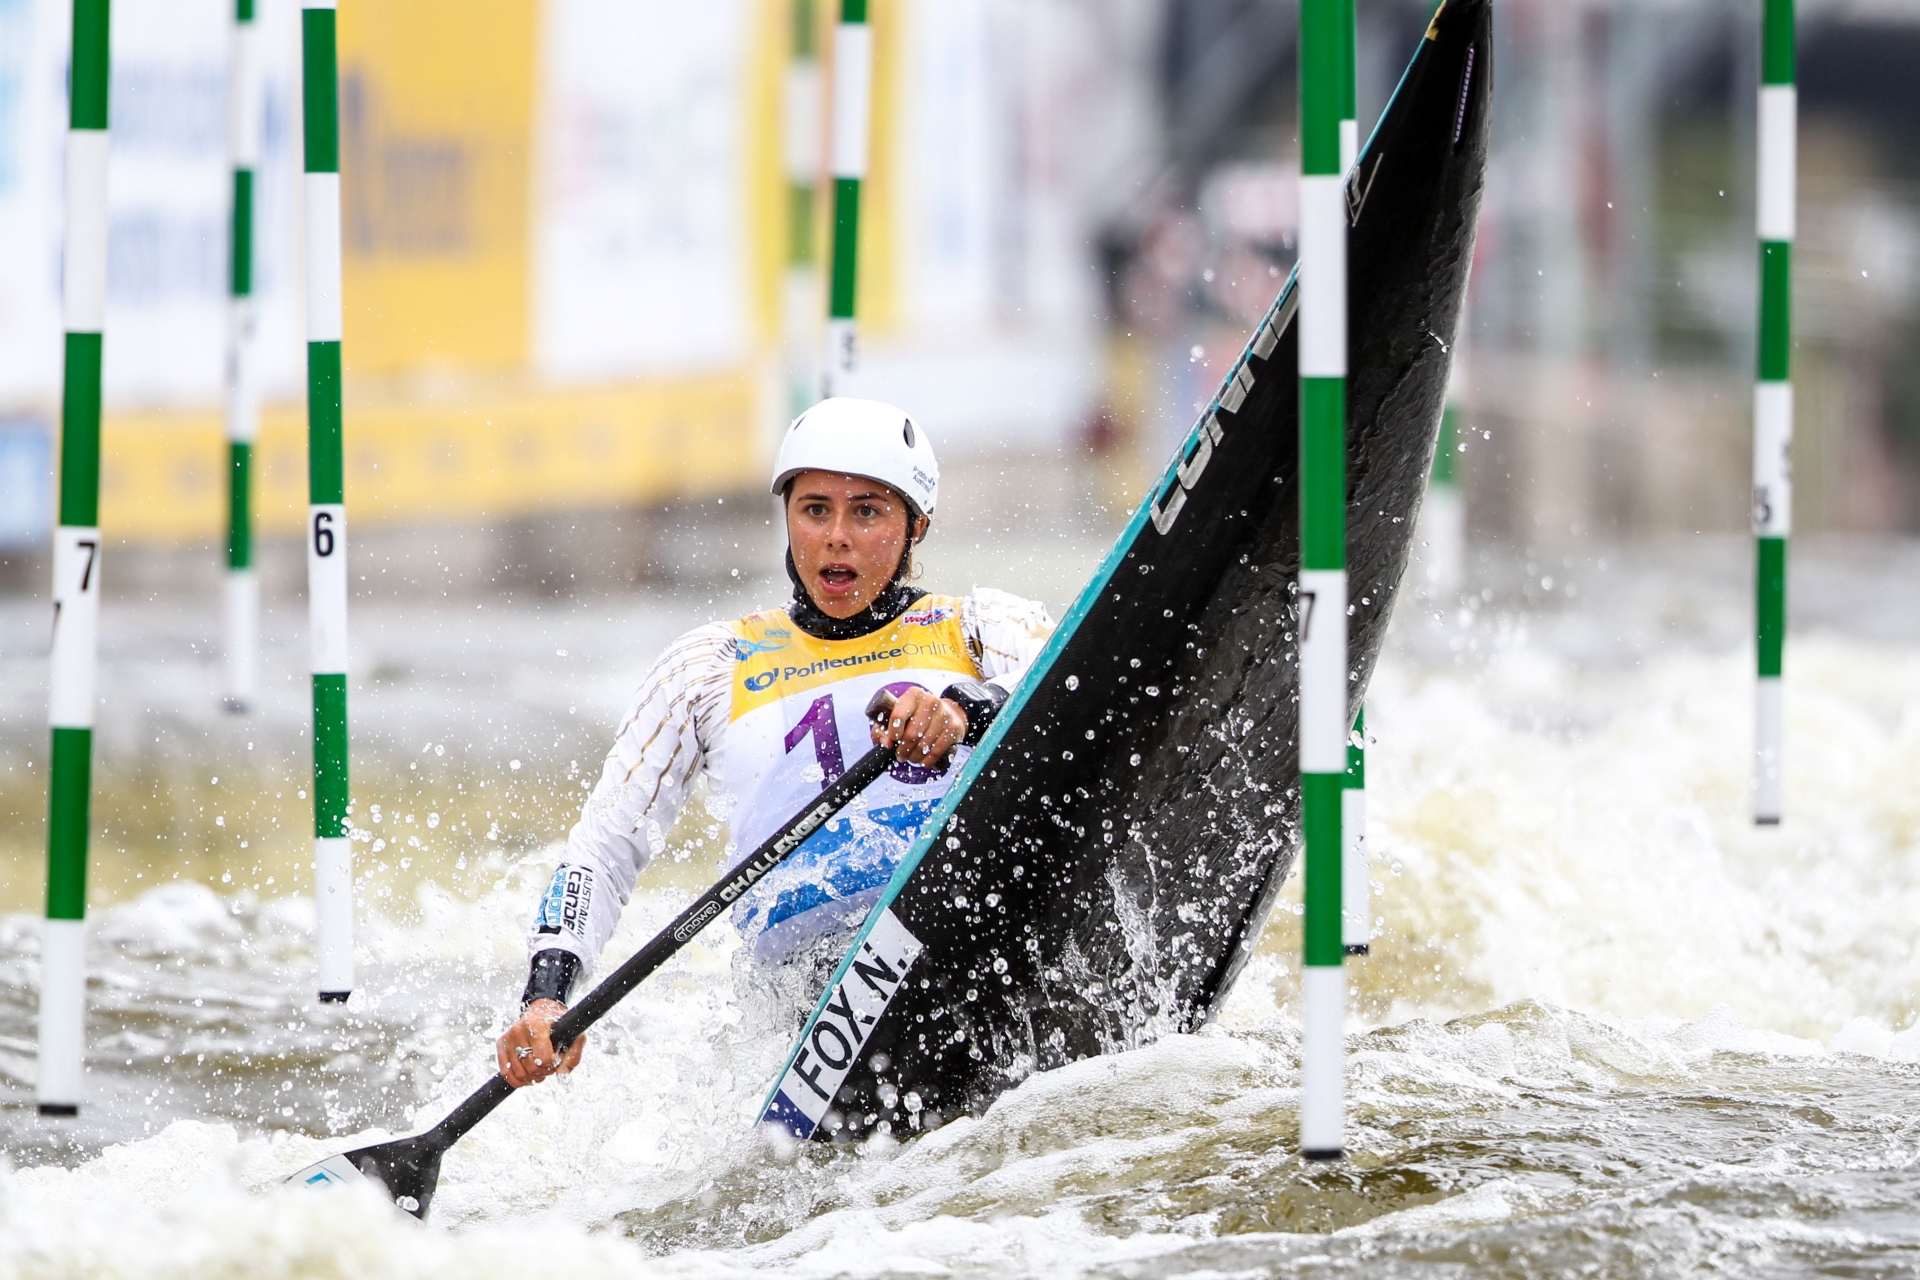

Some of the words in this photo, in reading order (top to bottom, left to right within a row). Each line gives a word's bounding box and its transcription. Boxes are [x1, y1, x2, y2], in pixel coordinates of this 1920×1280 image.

[314, 512, 334, 557] 6
[77, 542, 95, 592] 7
[1299, 592, 1316, 642] 7
[719, 802, 836, 902] CHALLENGER
[793, 984, 876, 1103] FOX
[851, 941, 908, 1002] N.
